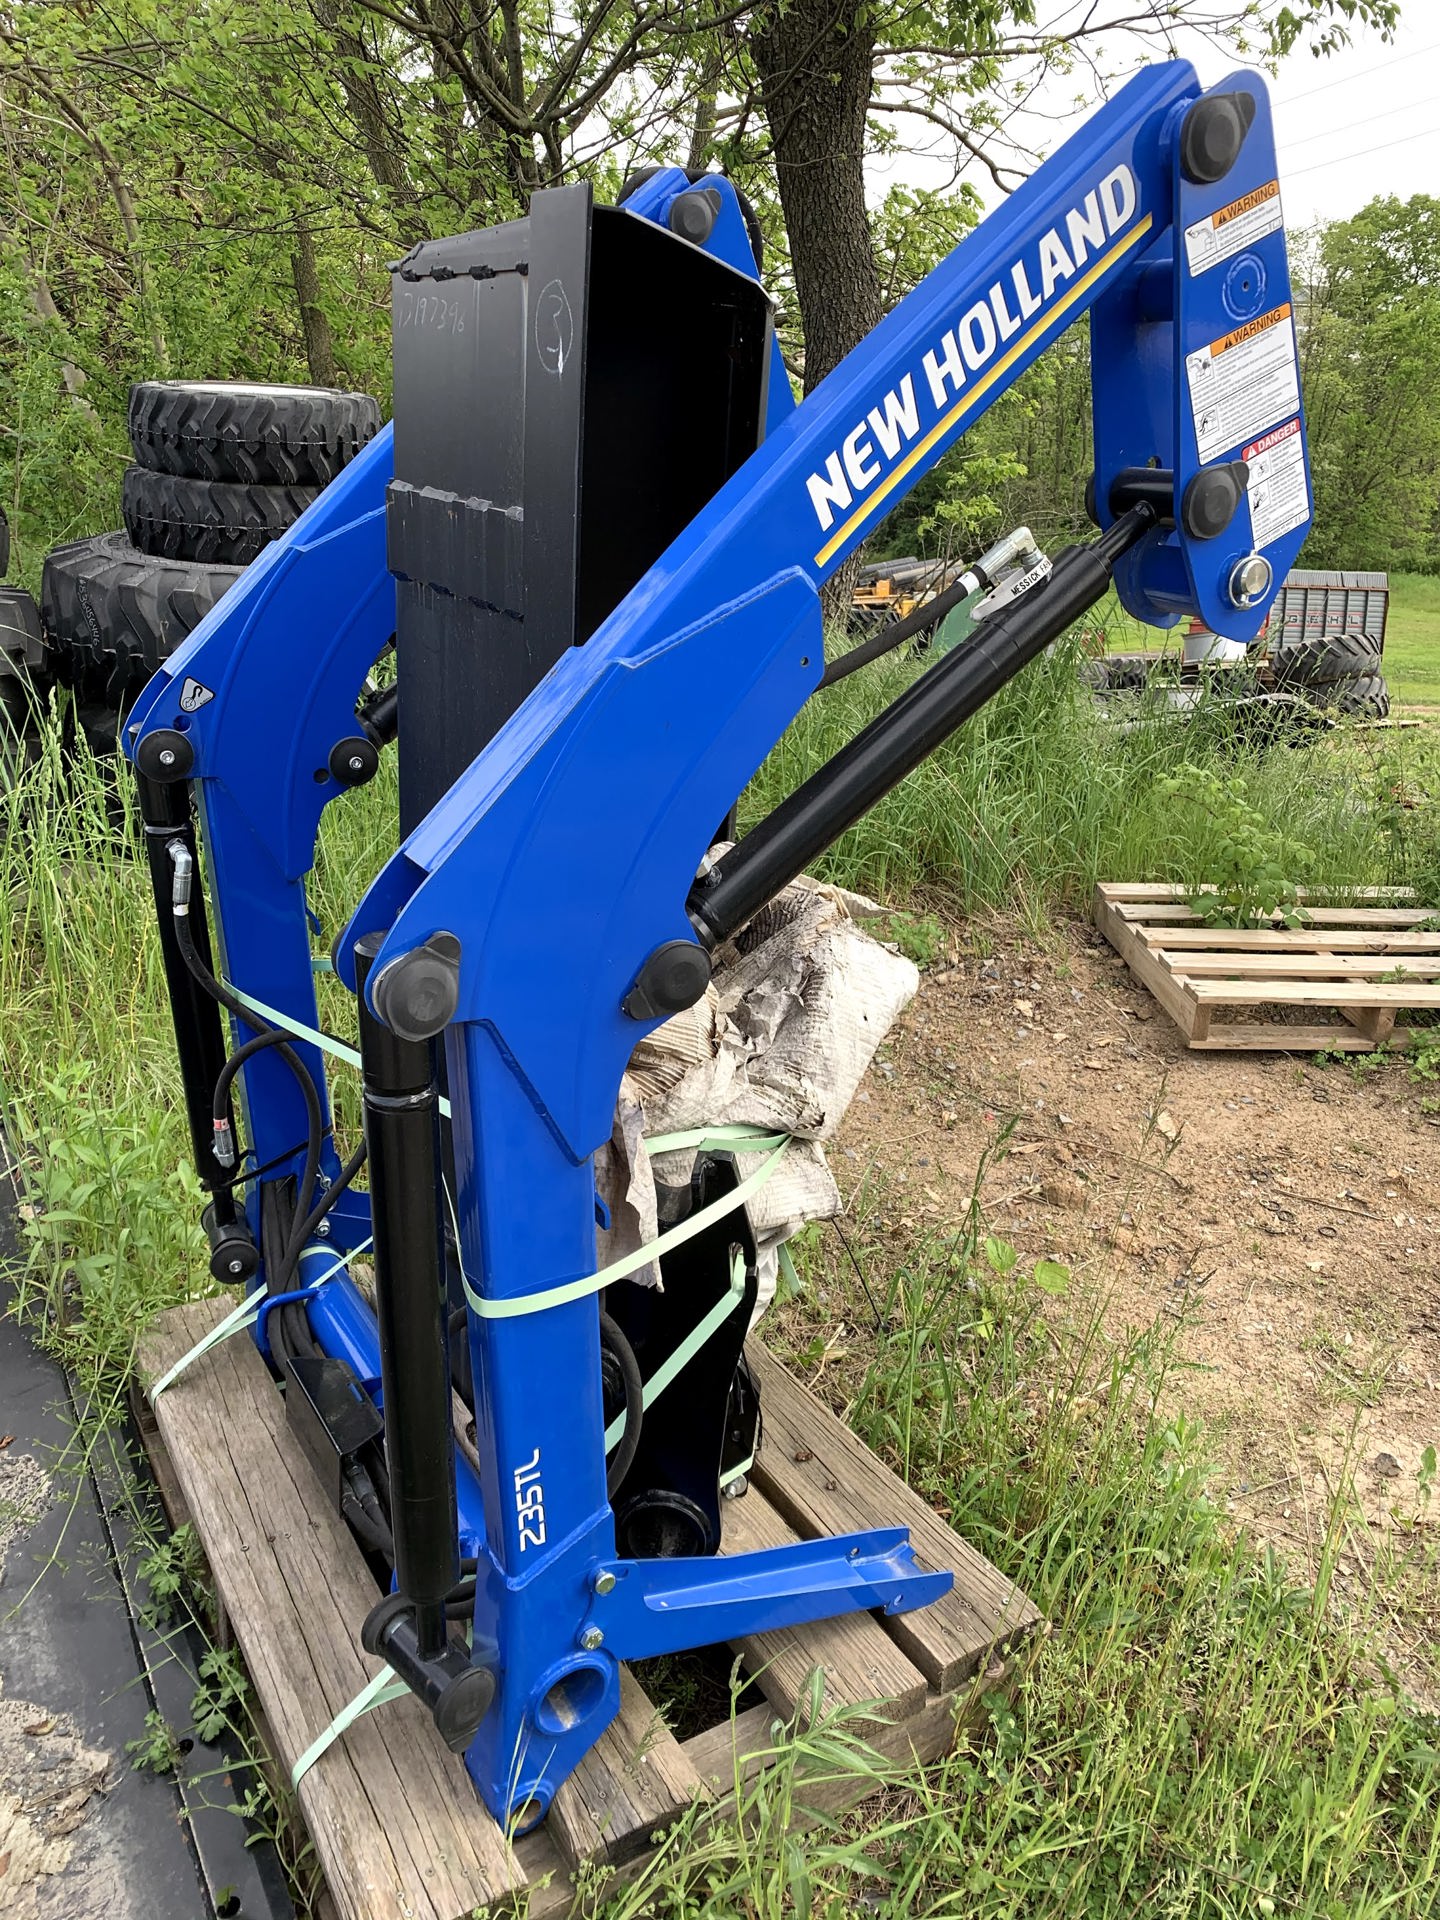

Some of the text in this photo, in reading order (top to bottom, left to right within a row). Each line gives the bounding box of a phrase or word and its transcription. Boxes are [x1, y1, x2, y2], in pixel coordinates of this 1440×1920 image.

[1227, 183, 1275, 219] WARNING
[1234, 310, 1281, 343] WARNING
[806, 372, 921, 531] NEW
[922, 164, 1137, 409] HOLLAND
[1258, 420, 1297, 451] DANGER
[1011, 572, 1041, 596] MESSICK
[514, 1448, 546, 1552] 235TL
